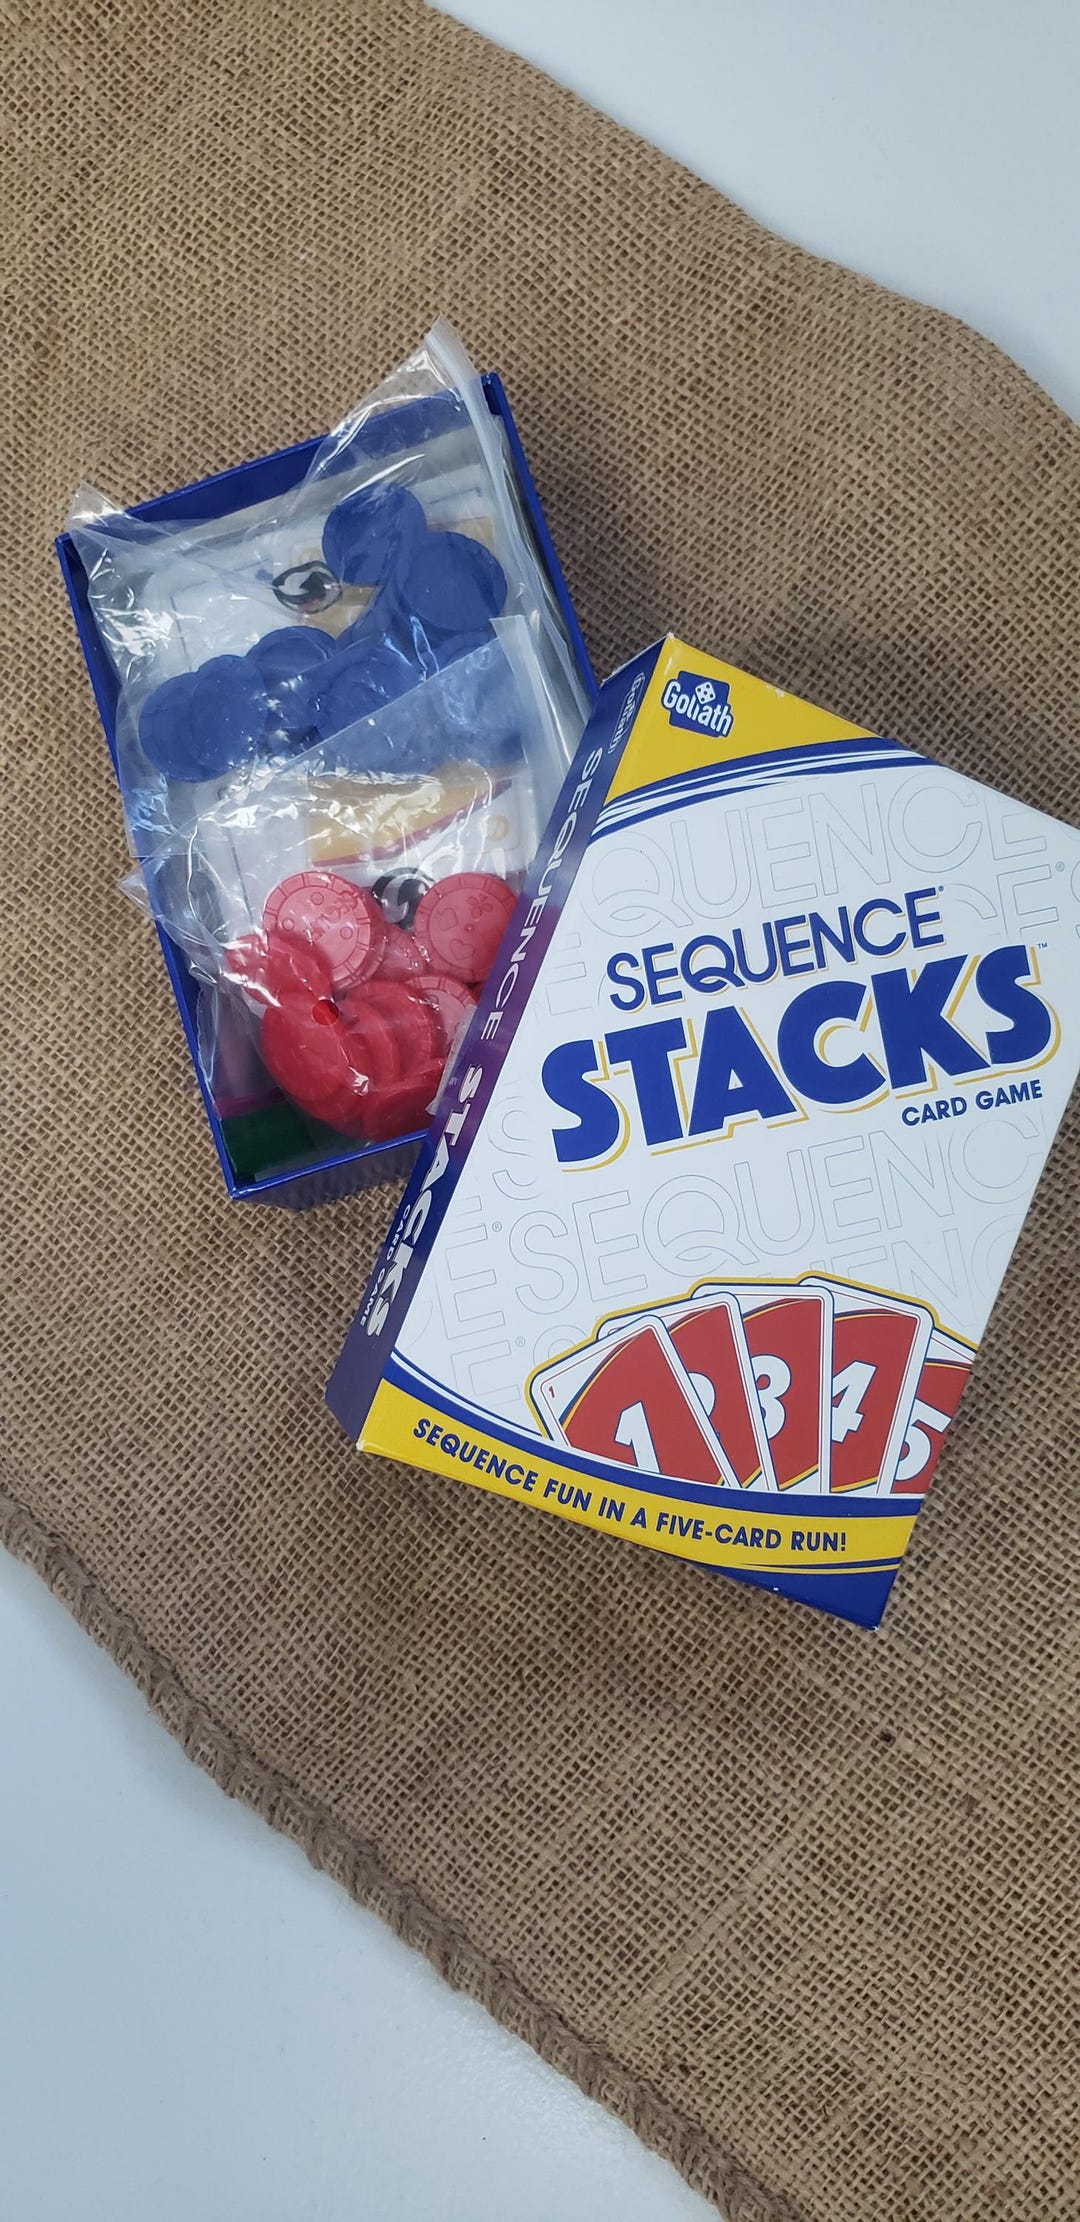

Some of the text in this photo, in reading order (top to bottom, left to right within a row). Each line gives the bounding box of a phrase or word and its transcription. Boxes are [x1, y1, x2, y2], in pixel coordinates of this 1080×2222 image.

[662, 679, 733, 736] Goliath
[481, 747, 602, 1040] SEQUENCE
[542, 944, 1056, 1167] STACKS
[902, 1079, 1043, 1126] CARD GAME
[367, 1063, 483, 1336] STACKS
[360, 1204, 411, 1326] CARD GAME
[547, 1385, 556, 1398] 1
[750, 1354, 792, 1440] 3
[832, 1360, 877, 1443] 4
[613, 1401, 662, 1474] 1
[895, 1398, 952, 1481] 5
[412, 1418, 847, 1551] SEQUENCE FUN IN A FIVE-CARD RUN!
